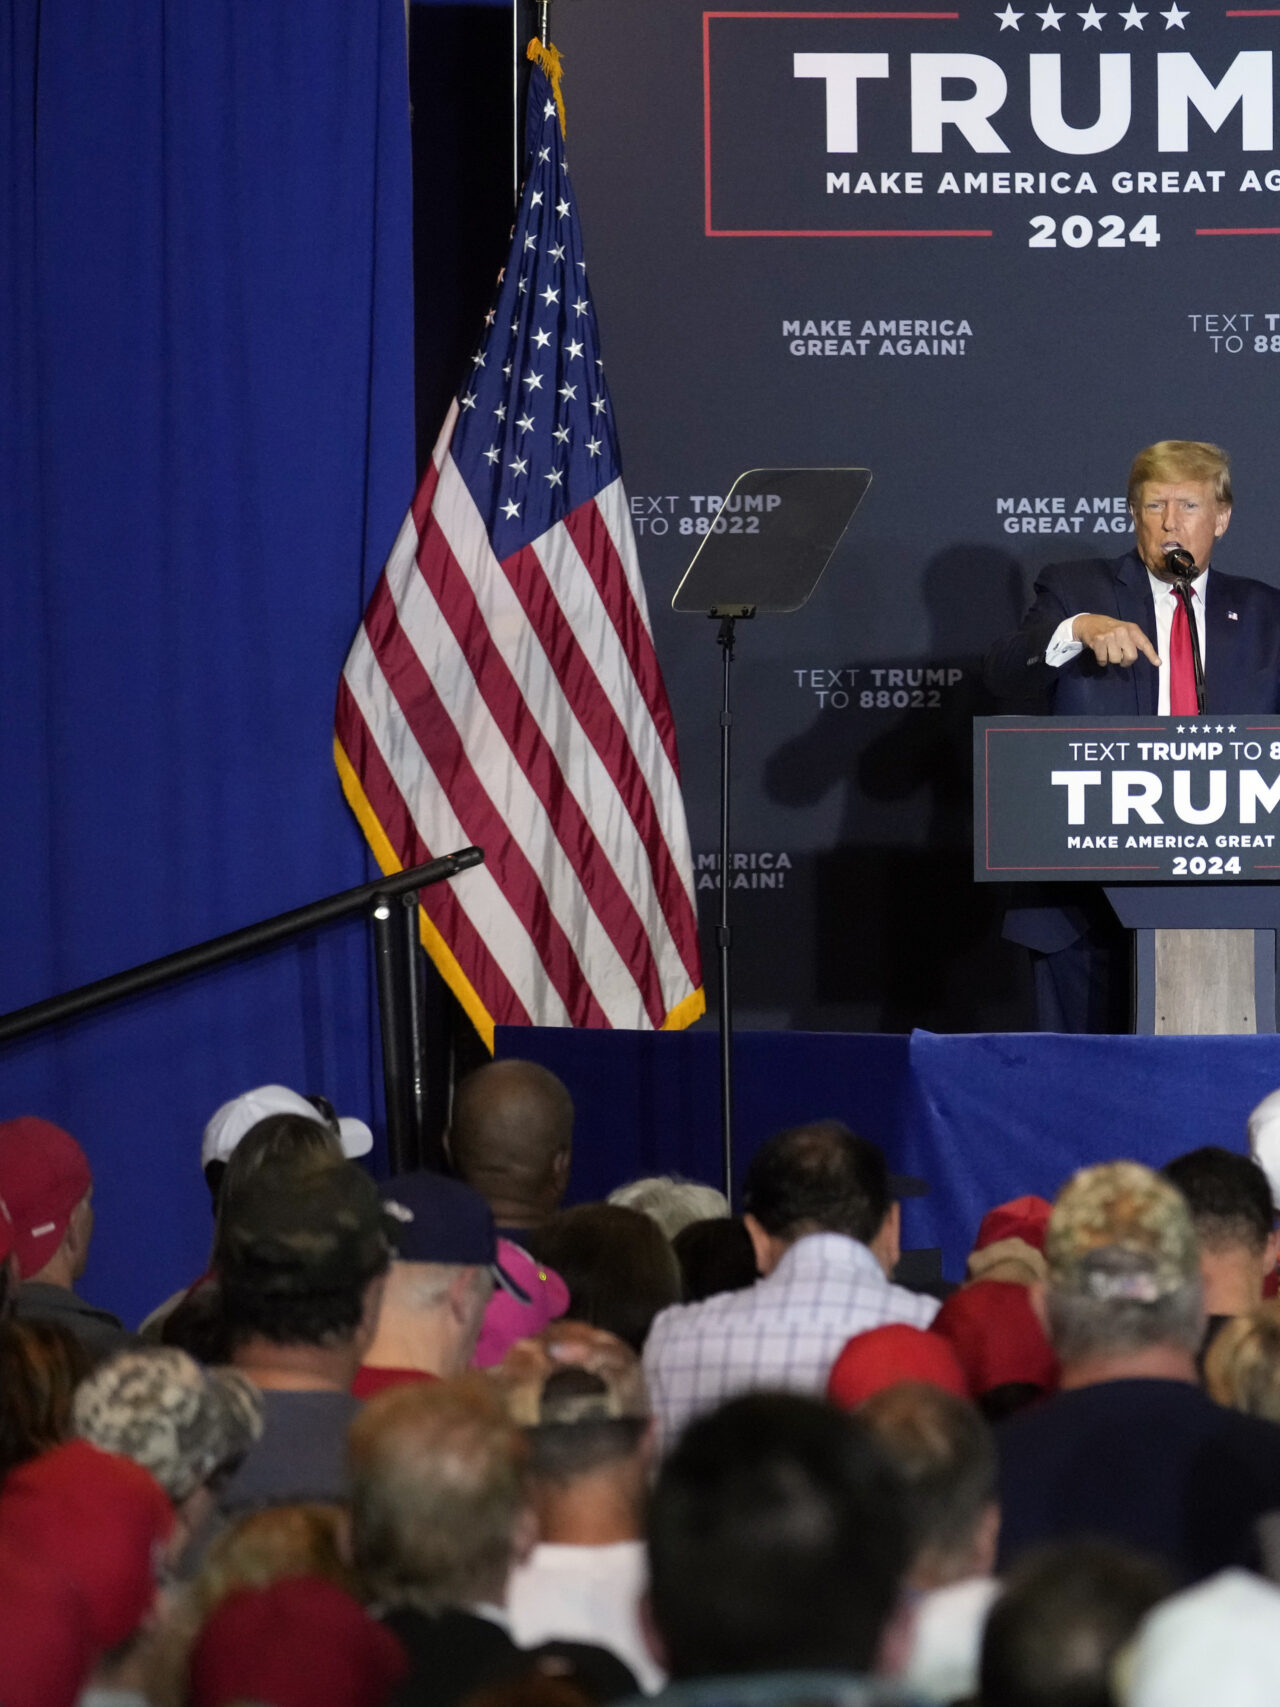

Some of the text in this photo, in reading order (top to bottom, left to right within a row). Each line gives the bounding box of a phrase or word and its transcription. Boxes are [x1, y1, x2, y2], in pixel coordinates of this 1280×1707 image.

[827, 172, 923, 193] MAKE
[938, 172, 1097, 194] AMERICA
[1112, 171, 1225, 193] GREAT
[1029, 215, 1160, 248] 2024
[783, 320, 972, 336] MAKE AMERICA
[1188, 314, 1253, 332] TEXT
[790, 340, 965, 356] GREAT AGAIN!
[1210, 336, 1243, 353] TO
[631, 495, 782, 514] EXT TRUMP
[997, 498, 1065, 513] MAKE
[636, 516, 760, 535] TO 88022
[1004, 517, 1084, 533] GREAT
[794, 669, 963, 687] TEXT TRUMP
[815, 690, 941, 708] TO 88022
[1069, 743, 1129, 760] TEXT
[1137, 742, 1223, 760] TRUMP
[1230, 742, 1261, 760] TO
[1068, 836, 1118, 848] MAKE
[1126, 836, 1208, 848] AMERICA
[1216, 835, 1275, 847] GREAT
[692, 853, 792, 870] MRICA
[1173, 857, 1241, 874] 2024
